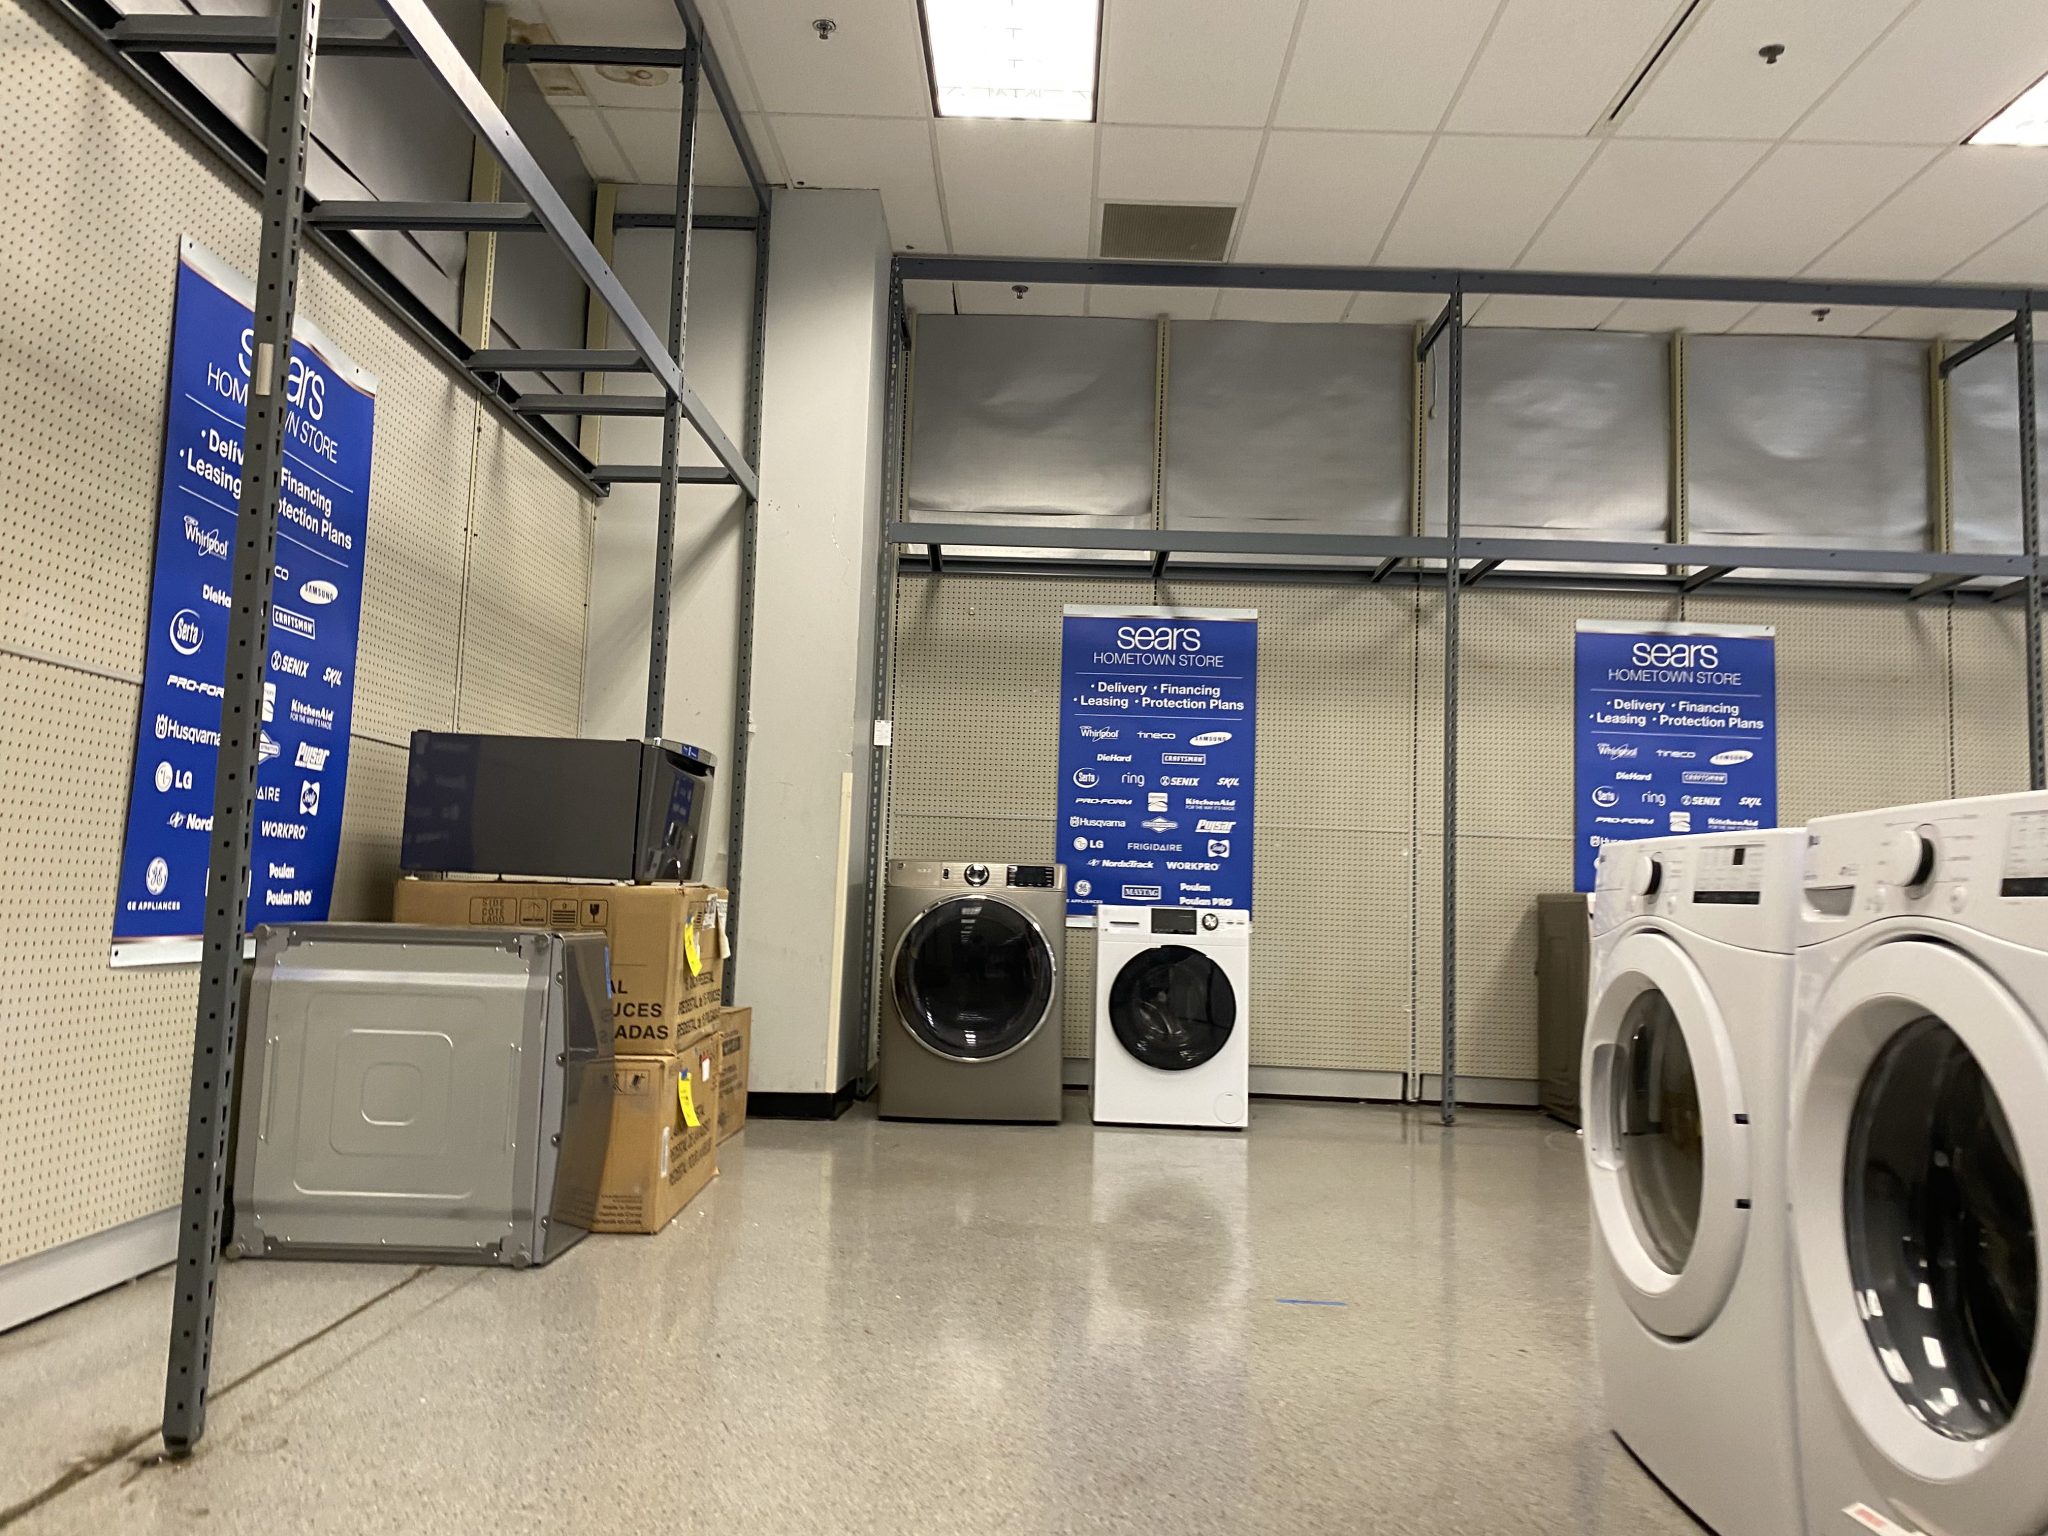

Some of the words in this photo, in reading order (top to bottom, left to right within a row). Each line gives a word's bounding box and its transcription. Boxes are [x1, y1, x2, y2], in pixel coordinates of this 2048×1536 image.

[238, 328, 325, 421] sars
[299, 420, 339, 464] STORE
[187, 448, 241, 499] Leasing
[321, 518, 352, 550] Plans
[280, 467, 332, 518] Financing
[184, 521, 229, 557] Whirlpool
[275, 609, 313, 634] CRAFTSMAN
[177, 617, 199, 644] Serta
[1117, 626, 1201, 652] sears
[1093, 652, 1176, 666] HOMETOWN
[1179, 654, 1225, 668] STORE
[1632, 642, 1719, 669] sears
[281, 655, 310, 678] SENIX
[322, 667, 343, 688] SKIL
[1608, 669, 1694, 683] HOMETOWN
[1696, 671, 1742, 686] STORE
[166, 674, 225, 699] PRO-FOR
[1098, 682, 1148, 696] Delivery
[1160, 683, 1221, 699] Financing
[291, 698, 334, 722] KitchenAid
[1081, 696, 1129, 709] Leasing
[1142, 697, 1206, 709] Protection
[1209, 699, 1245, 711] Plans
[1613, 699, 1665, 712] Delivery
[1678, 701, 1740, 716] Financing
[1596, 713, 1646, 726] Leasing
[1659, 715, 1726, 728] Protection
[1728, 717, 1764, 729] Plans
[1080, 726, 1120, 742] Whirlpool
[1137, 731, 1176, 740] tineco
[296, 742, 331, 769] Pulsar
[1096, 753, 1133, 763] DieHard
[1164, 755, 1205, 764] CRAFTSMAN
[175, 769, 193, 790] LG
[1078, 771, 1095, 784] Serta
[1121, 772, 1146, 788] ring
[1170, 777, 1201, 787] SENIX
[1216, 777, 1240, 788] SKIL
[1615, 771, 1652, 781] DieHard
[1075, 797, 1133, 805] PRO-FORM
[1185, 798, 1236, 806] KitchenAid
[1641, 790, 1666, 807] ring
[1691, 796, 1721, 806] SENIX
[1738, 796, 1762, 808] SKIL
[1079, 817, 1126, 828] Husqvarna
[1595, 816, 1655, 825] PRO-FORM
[261, 820, 306, 840] WORKPRO
[1089, 840, 1105, 849] LG
[1127, 842, 1183, 852] FRIGIDAIRE
[269, 862, 295, 879] Poulan
[1102, 860, 1154, 869] NordicTrack
[1166, 861, 1219, 871] WORKPRO
[1125, 888, 1160, 898] MAYTAG
[1180, 883, 1211, 892] Poulan
[266, 888, 292, 906] Poulan
[293, 890, 312, 905] PRO
[482, 897, 505, 907] SIDE
[1179, 897, 1211, 906] Poulan
[1212, 898, 1233, 907] PRO
[127, 901, 137, 911] GE
[138, 901, 181, 911] APPLIANCES
[614, 1025, 669, 1040] ADAS
